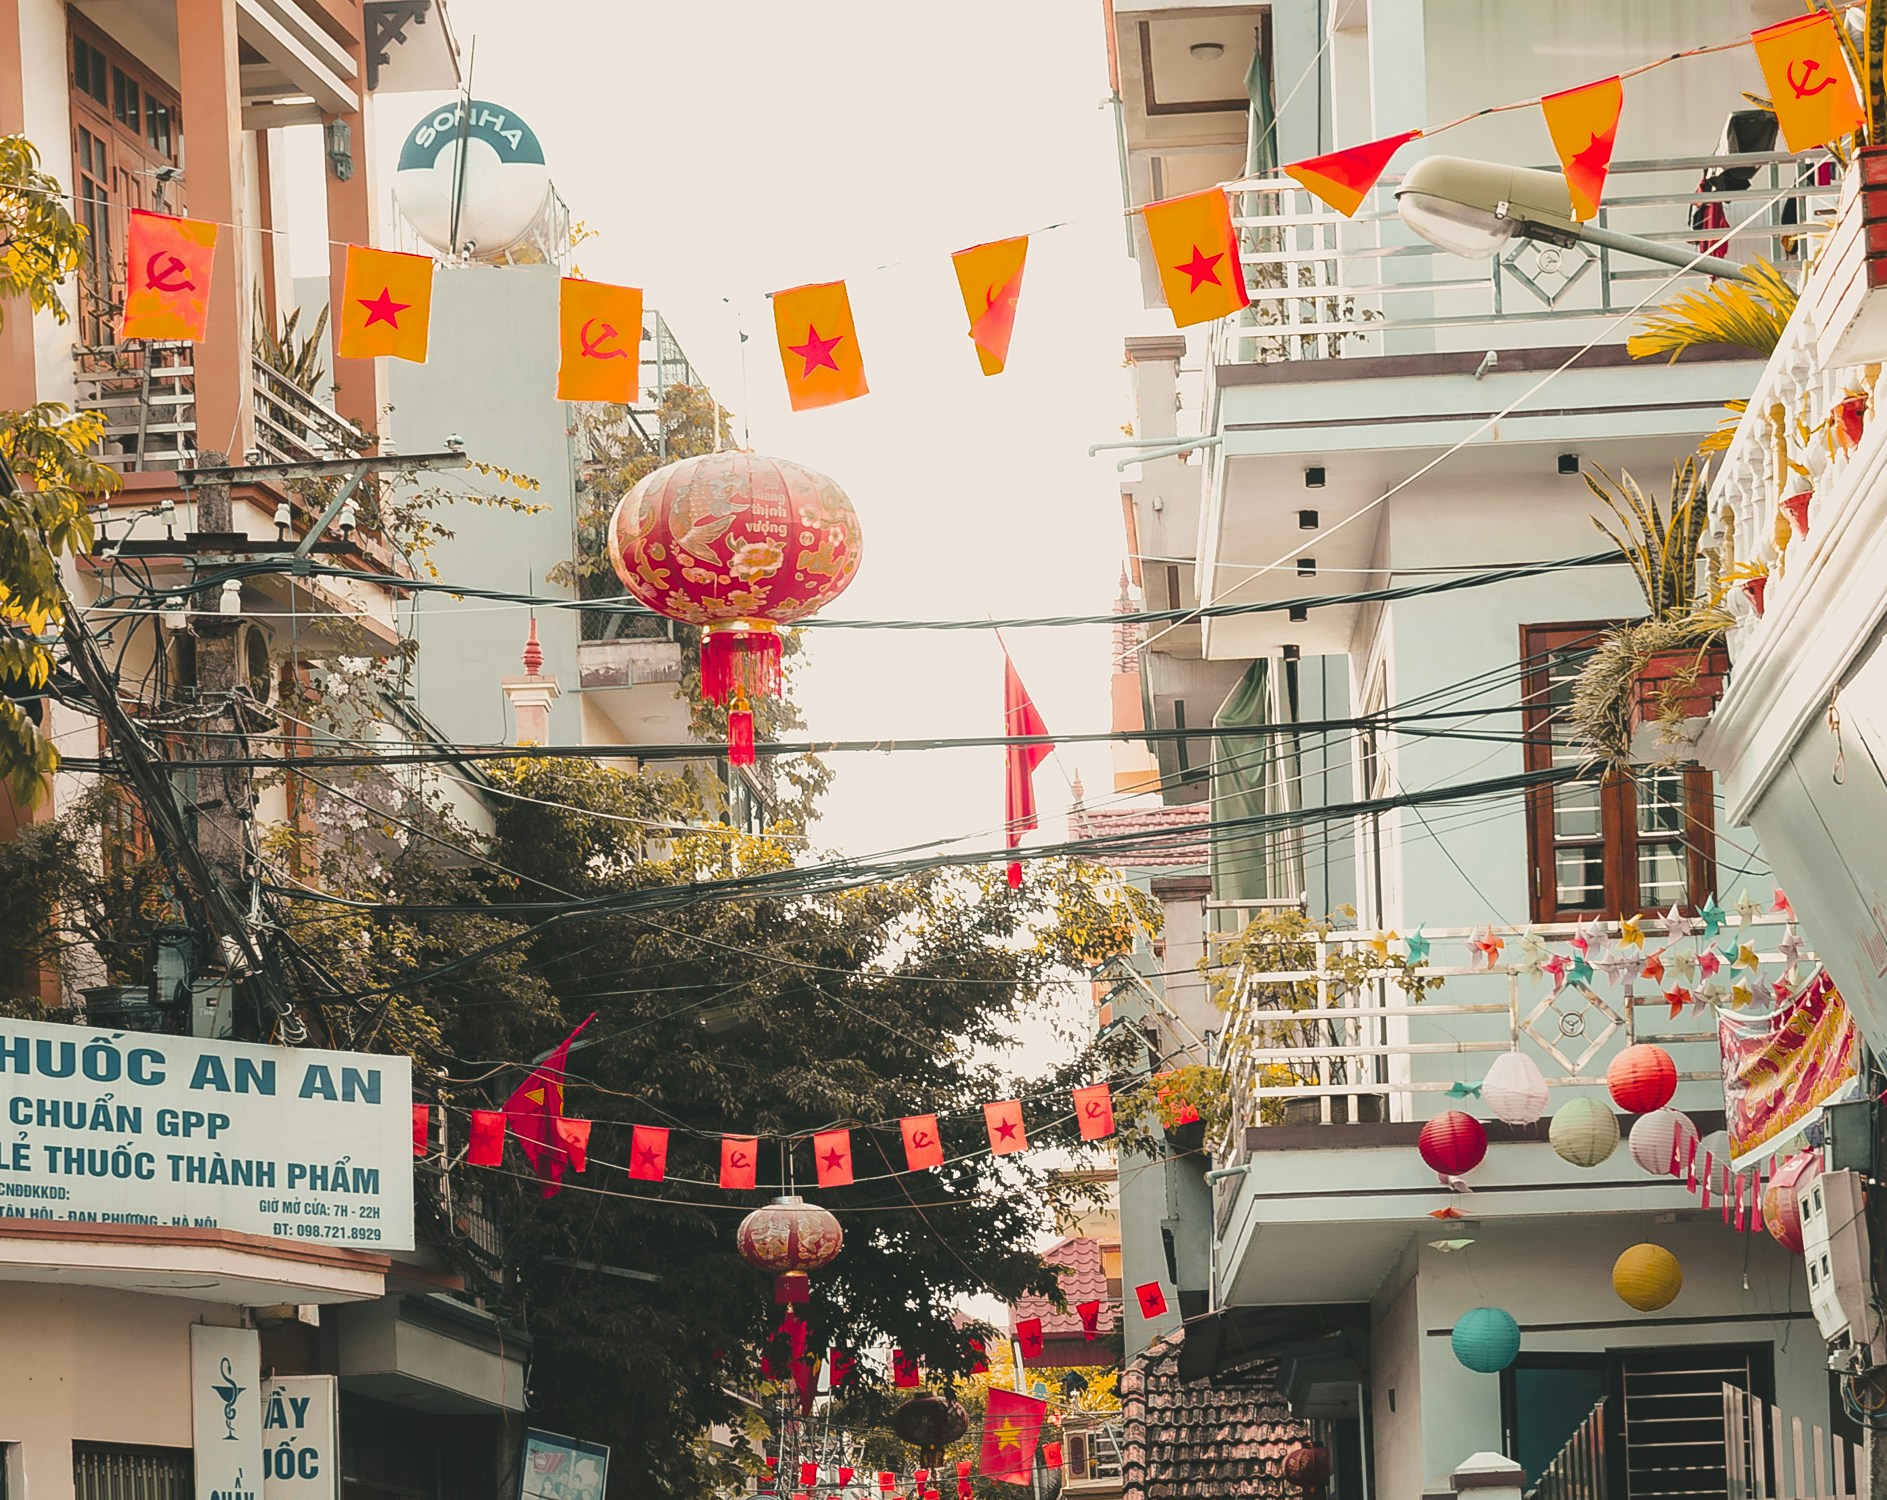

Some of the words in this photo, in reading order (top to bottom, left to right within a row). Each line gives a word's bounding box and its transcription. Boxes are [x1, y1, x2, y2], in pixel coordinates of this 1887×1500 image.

[751, 503, 787, 519] thịnh
[745, 520, 787, 537] vượng
[190, 1054, 276, 1096] AN
[298, 1064, 382, 1105] AN
[9, 1093, 142, 1134] CHUẨN
[156, 1108, 231, 1140] GPP
[43, 1141, 155, 1180] THUỐC
[167, 1149, 276, 1189] THÀNH
[287, 1155, 380, 1195] PHẨM
[259, 1197, 279, 1213] GIỜ
[282, 1196, 301, 1214] MỞ
[304, 1197, 330, 1216] CỬA:
[334, 1204, 348, 1217] 7H
[359, 1206, 380, 1219] 22H
[273, 1222, 293, 1236] ĐT:
[297, 1224, 381, 1241] 098.721.8929
